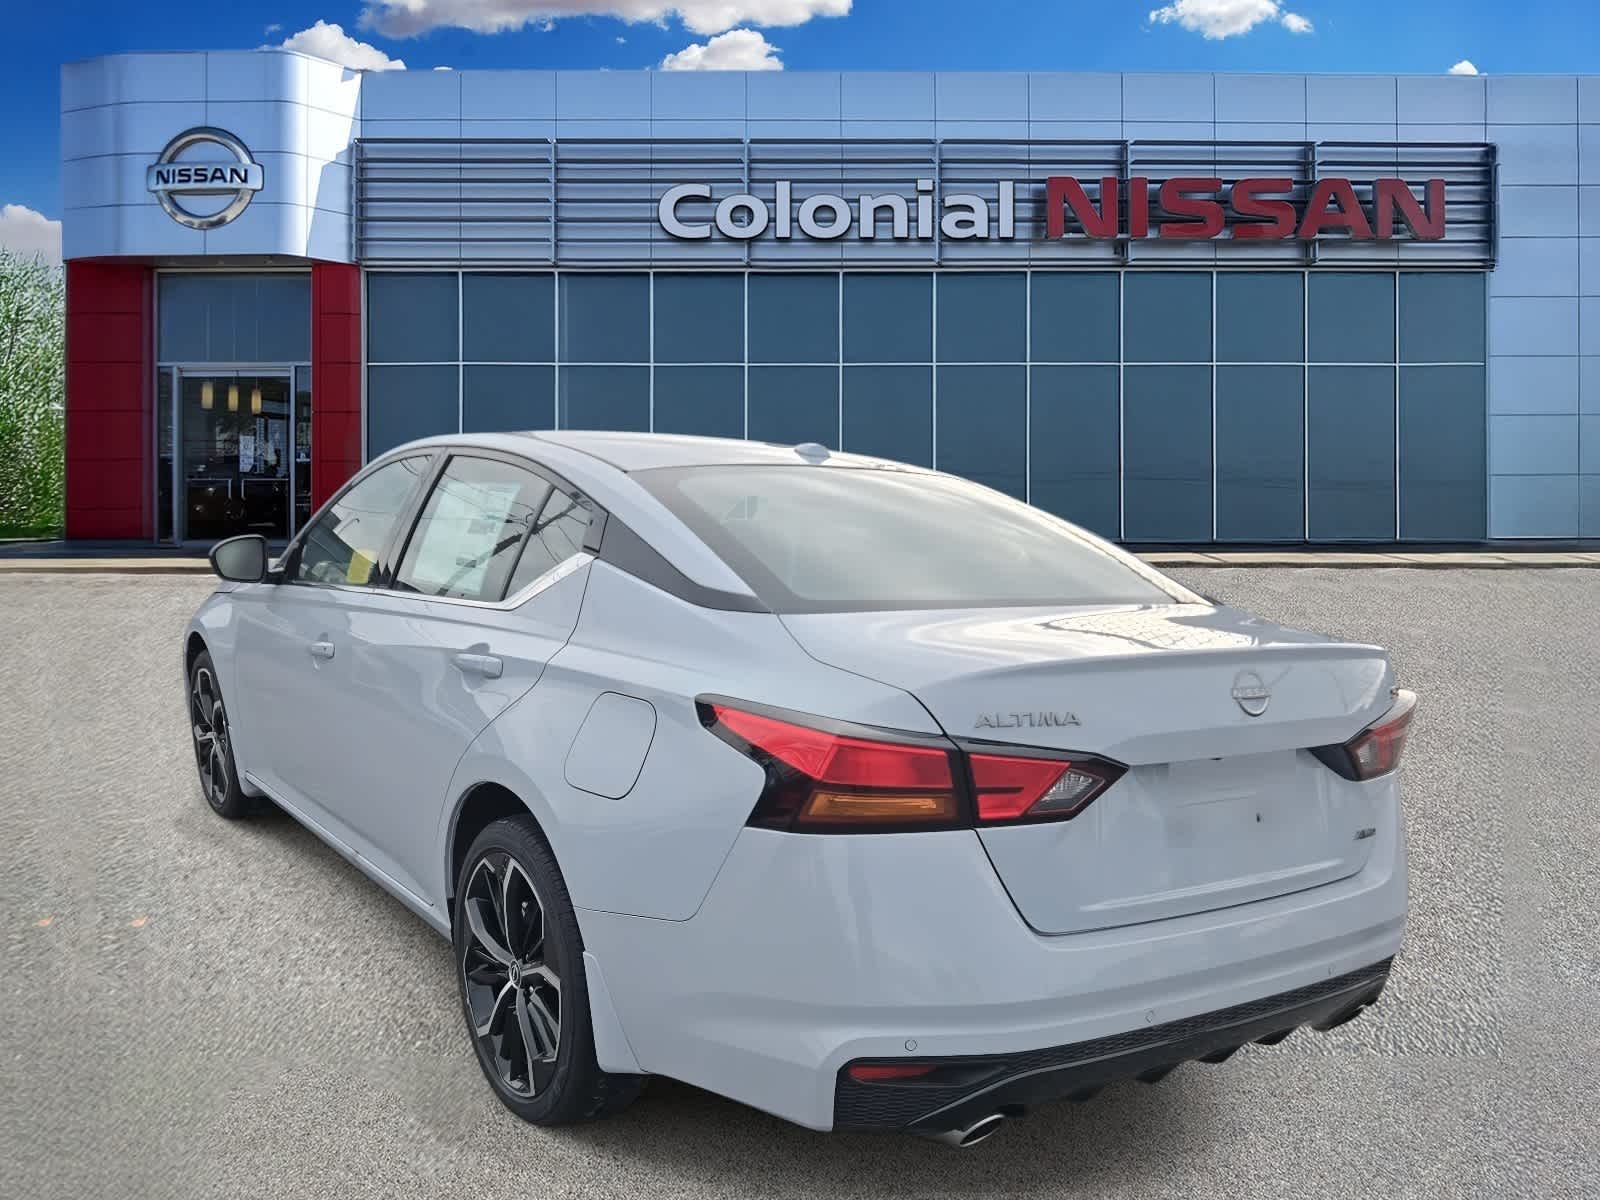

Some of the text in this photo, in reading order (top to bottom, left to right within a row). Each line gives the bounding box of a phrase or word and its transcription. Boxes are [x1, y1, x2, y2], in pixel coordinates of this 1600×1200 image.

[156, 168, 248, 185] NISSAN
[657, 176, 1446, 241] Colonial NISSAN
[974, 711, 1081, 729] ALTIMA
